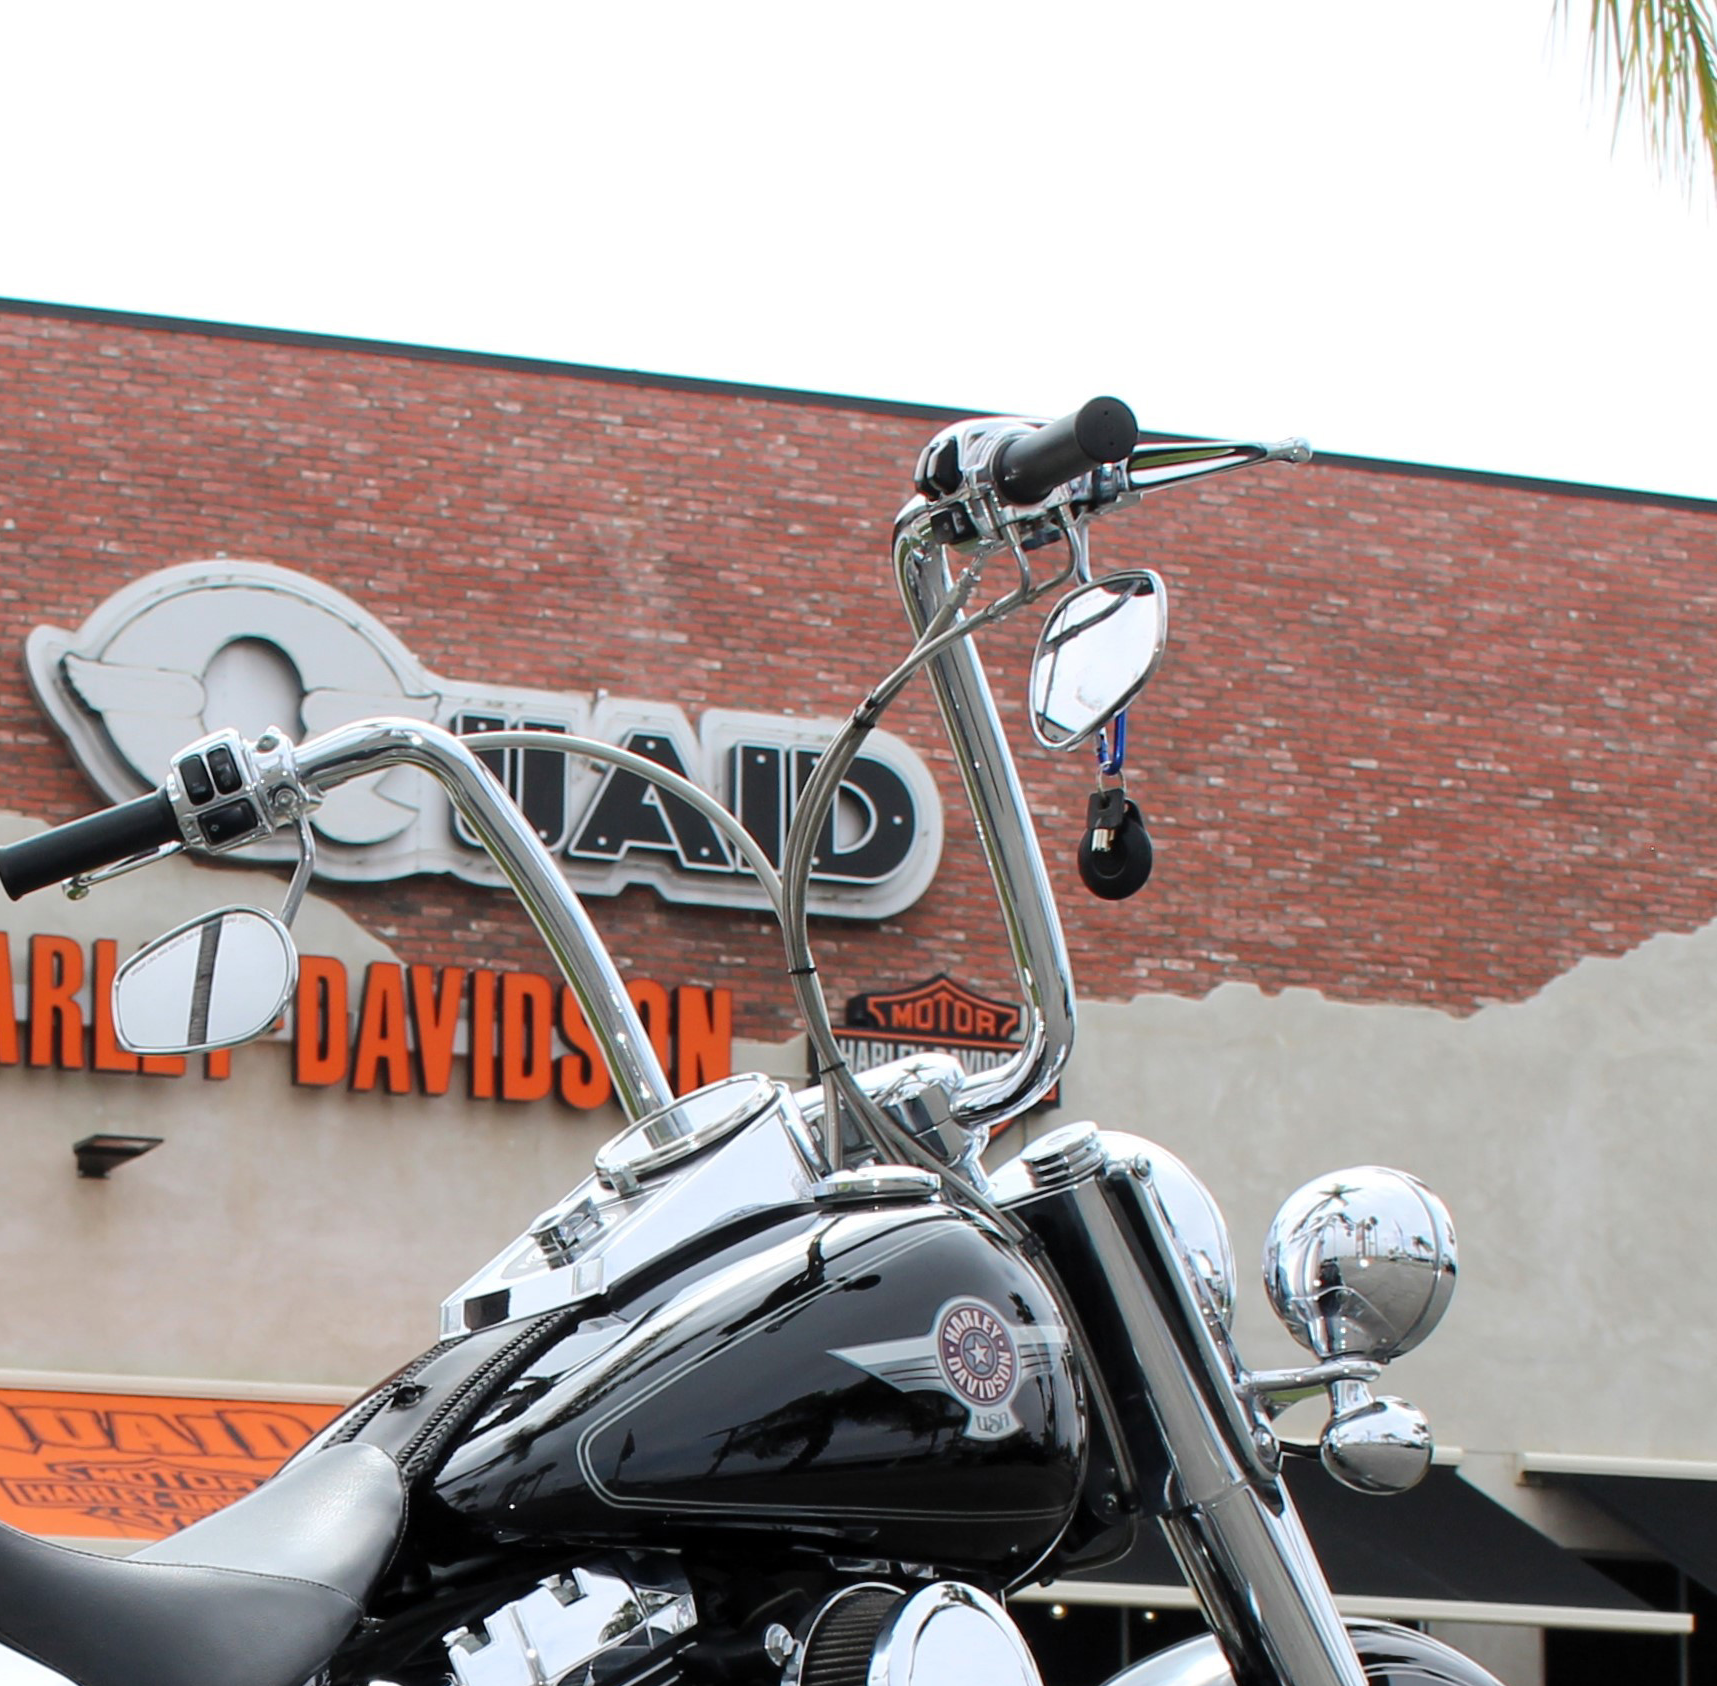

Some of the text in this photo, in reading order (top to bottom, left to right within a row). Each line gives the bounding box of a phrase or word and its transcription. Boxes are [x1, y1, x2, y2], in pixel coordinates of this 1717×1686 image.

[60, 583, 916, 884] QUAID
[890, 991, 999, 1037] MOTOR
[944, 1309, 1003, 1345] HARLEY
[947, 1350, 1012, 1399] DAVIDSON
[976, 1411, 1010, 1434] USA
[85, 1465, 260, 1491] MOTOR
